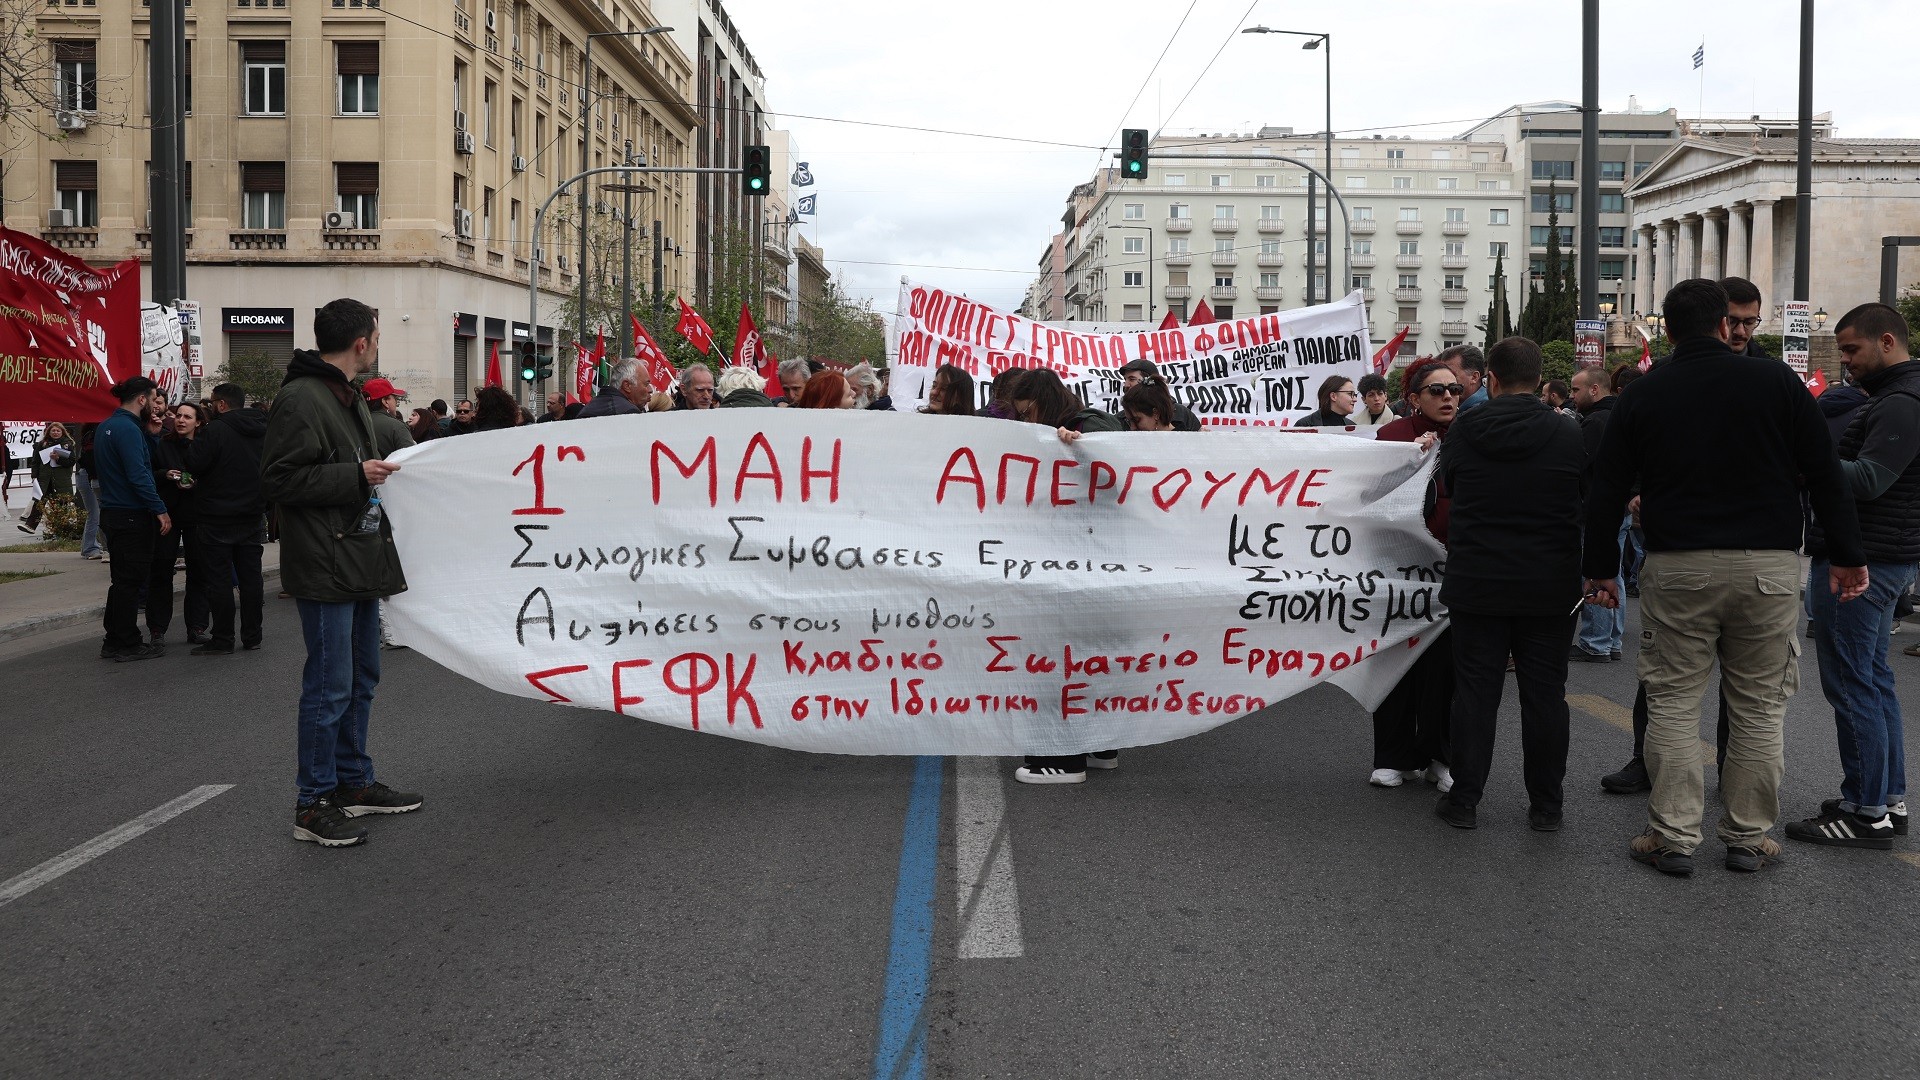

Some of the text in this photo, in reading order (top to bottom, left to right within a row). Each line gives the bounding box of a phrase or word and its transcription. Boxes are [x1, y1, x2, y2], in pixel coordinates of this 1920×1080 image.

[230, 315, 285, 325] EUROBANK
[909, 286, 1282, 368] ΦΟΙΤΗΤΕΣ ΕΡΓΑΤΙΑ ΜΙΑ ΦΩΝΗ
[898, 331, 934, 367] ΚΑΙ
[1232, 340, 1289, 362] ΔΗΜΟΣΙΑ
[1260, 376, 1312, 412] ΤΟΥΣ
[511, 432, 1332, 515] 1η ΜΑΗ ΑΠΕΡΓΟΥΜΕ
[727, 516, 943, 572] Συμβασεις
[1228, 513, 1286, 566] με
[1304, 523, 1352, 558] το
[748, 612, 841, 634] στους
[872, 597, 995, 635] μισθούς
[782, 638, 944, 678] Κλαδικό
[985, 633, 1199, 680] Σωματείο
[790, 677, 1267, 722] στην Ιδιωτικη Εκπαίδευση
